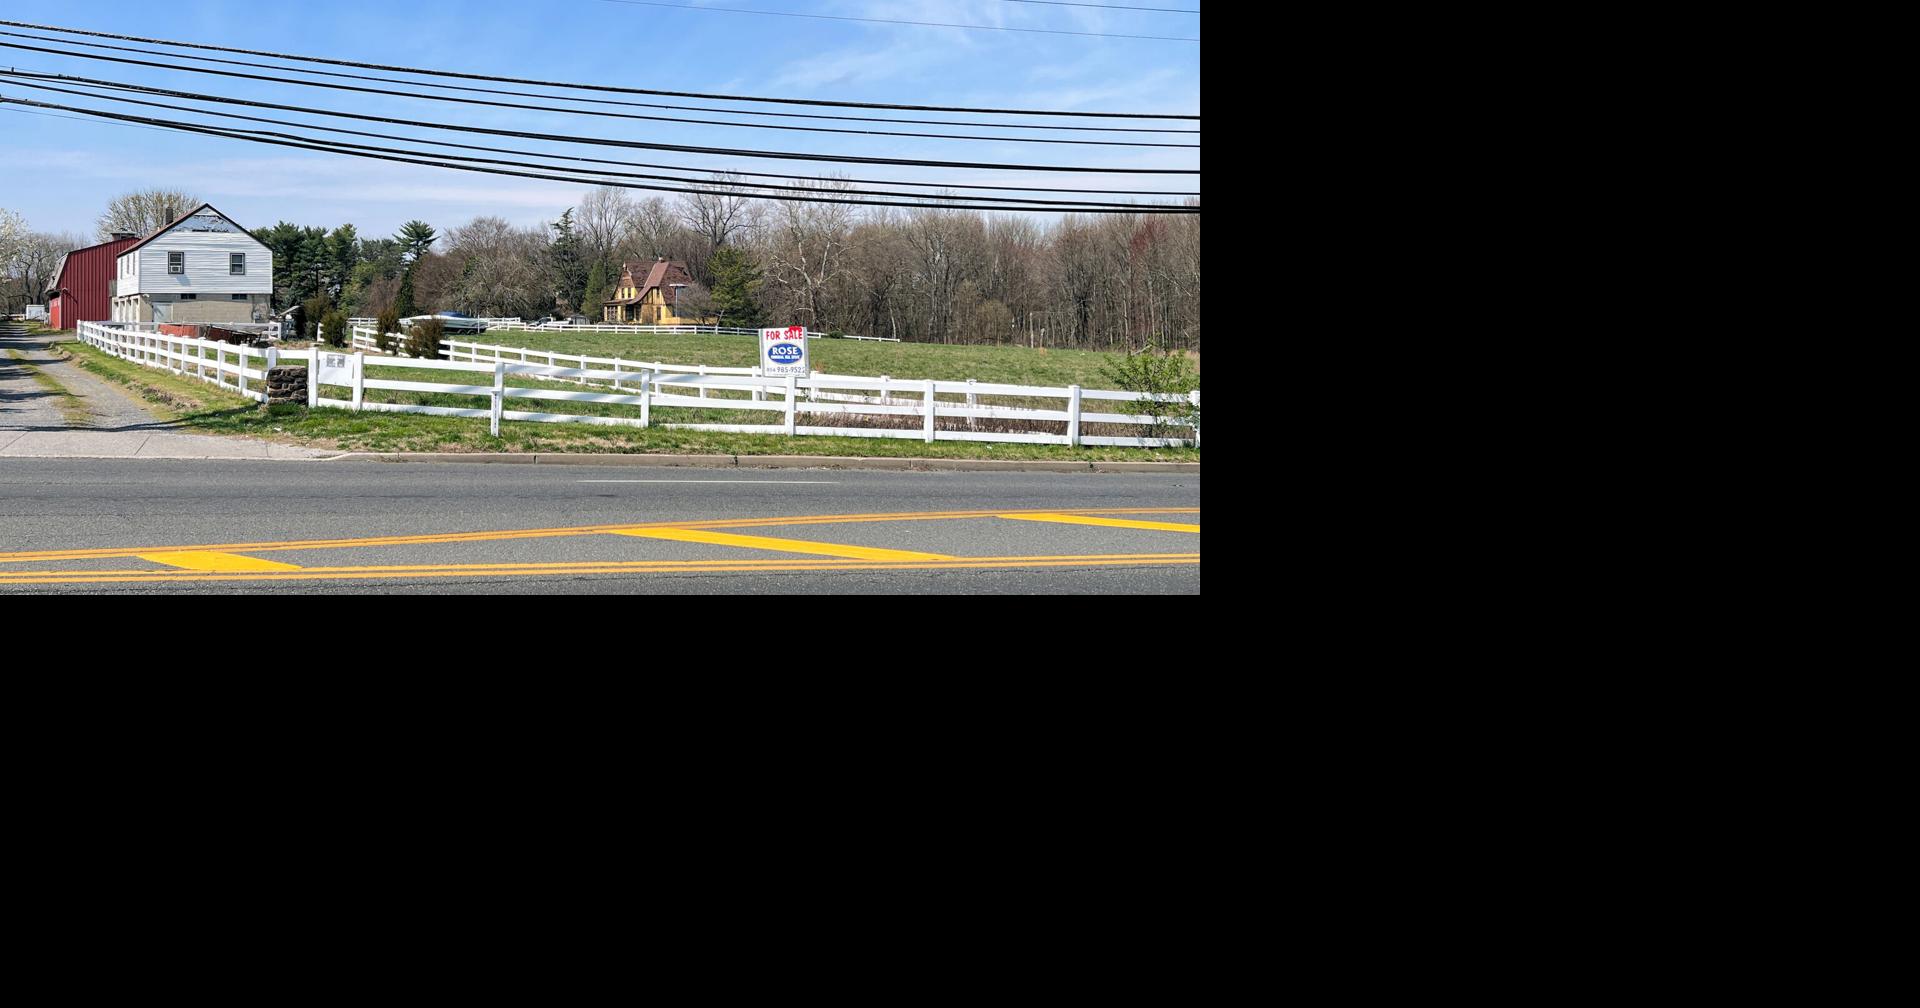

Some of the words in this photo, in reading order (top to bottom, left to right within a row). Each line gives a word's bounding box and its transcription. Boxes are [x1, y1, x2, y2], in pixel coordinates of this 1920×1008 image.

[766, 330, 780, 340] FOR
[784, 330, 803, 340] SALE
[772, 347, 798, 355] ROSE
